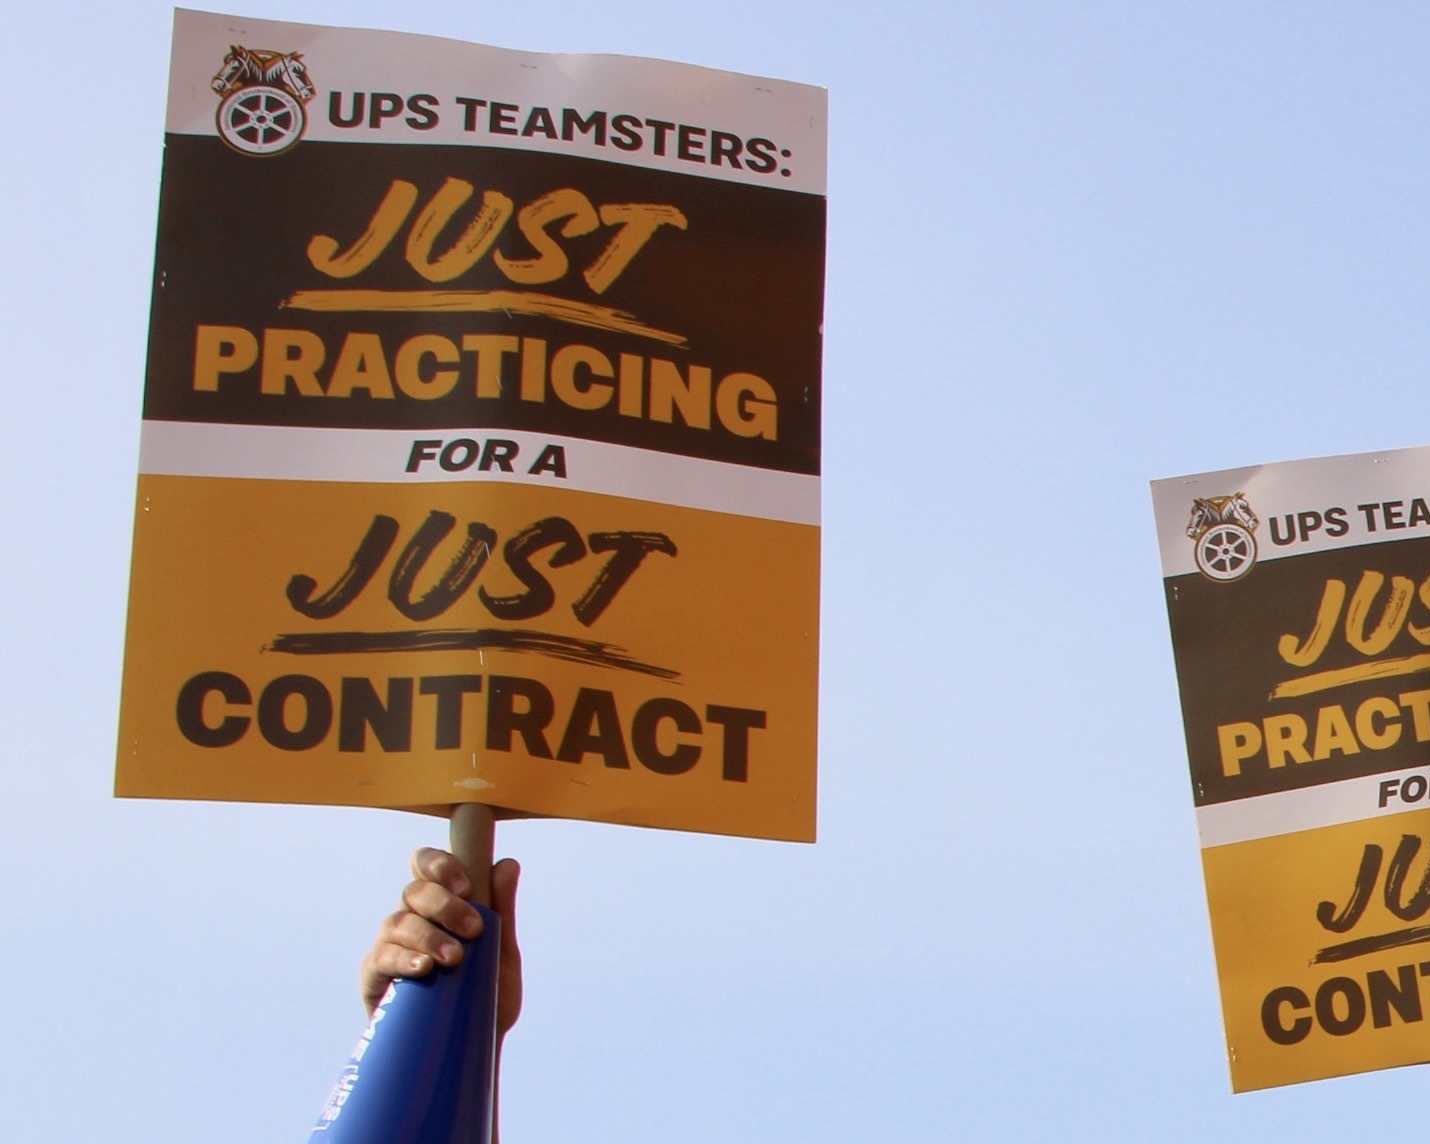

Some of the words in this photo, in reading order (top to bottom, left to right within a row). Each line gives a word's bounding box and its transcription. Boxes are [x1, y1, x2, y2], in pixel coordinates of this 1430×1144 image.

[328, 91, 440, 132] UPS
[456, 96, 793, 178] TEAMSTERS:
[307, 177, 688, 294] JUST
[193, 325, 779, 441] PRACTICING
[405, 438, 520, 474] FOR
[528, 444, 568, 479] A
[286, 509, 678, 628] JUST
[1268, 506, 1349, 548] UPS
[174, 671, 767, 783] CONTRACT
